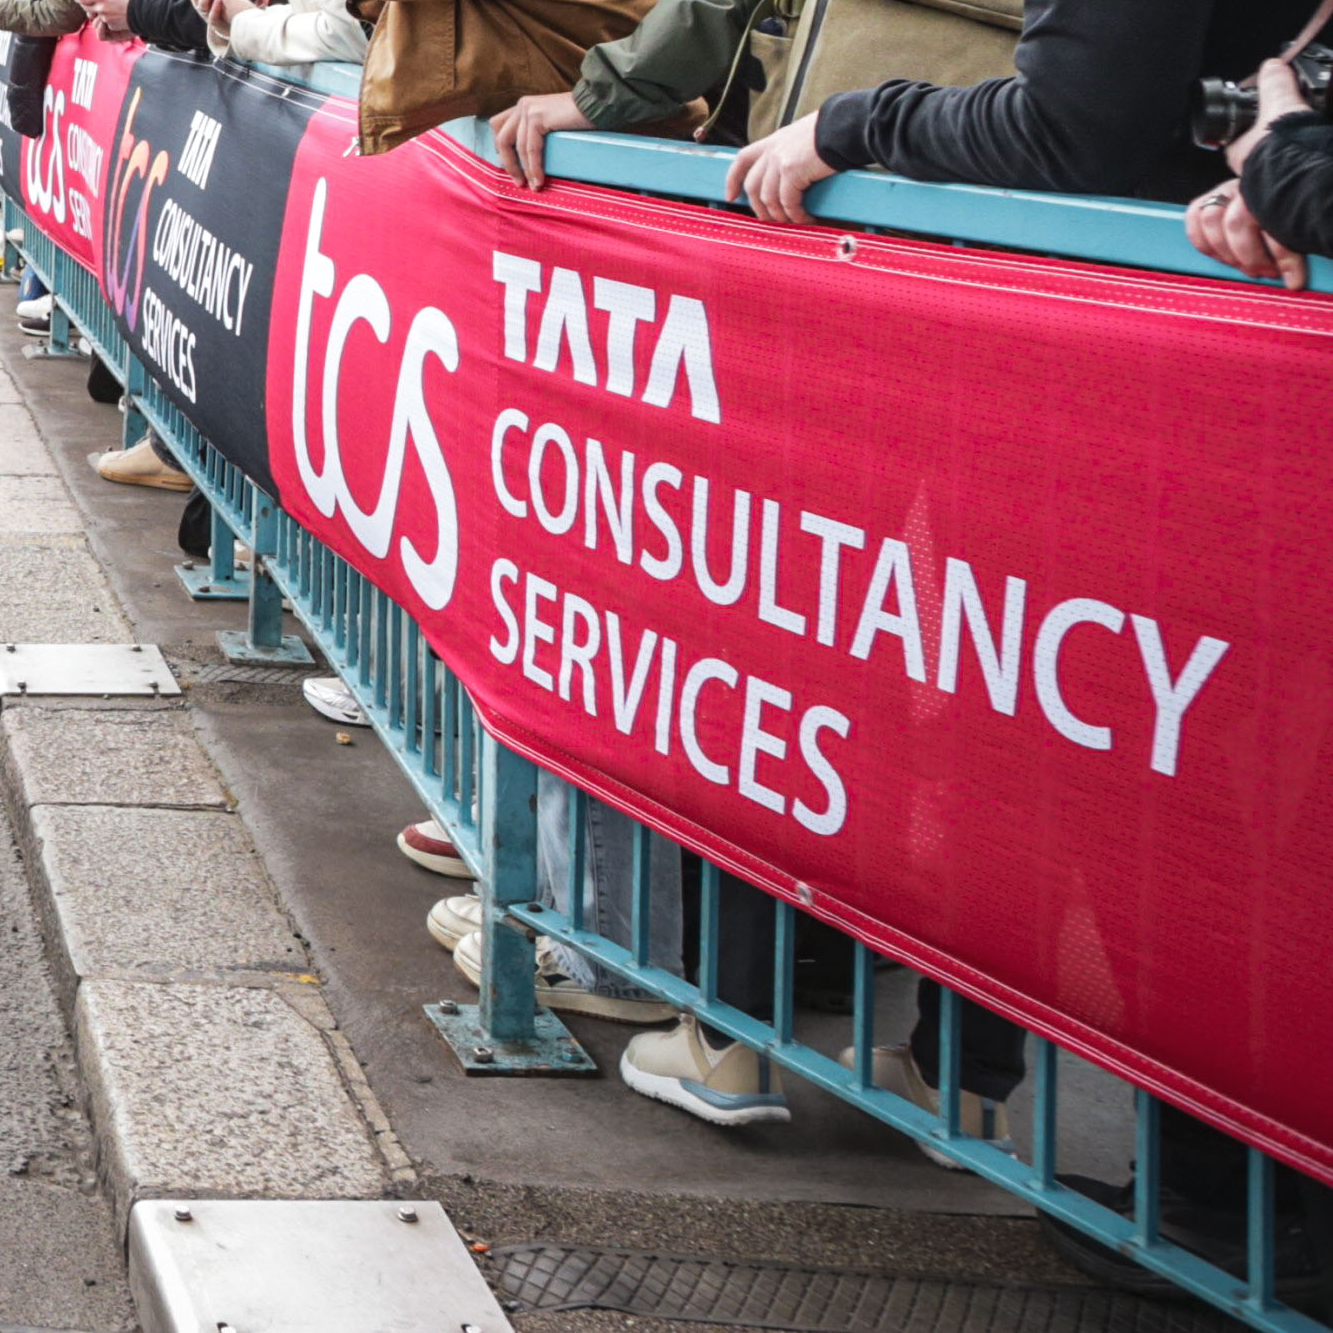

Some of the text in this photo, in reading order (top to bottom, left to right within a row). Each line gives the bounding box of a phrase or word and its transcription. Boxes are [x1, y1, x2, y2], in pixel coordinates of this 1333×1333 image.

[107, 87, 169, 332] tcs
[177, 111, 222, 190] TATA
[141, 287, 197, 404] SERVICES
[152, 198, 253, 336] CONSULTANCY
[492, 250, 721, 424] TATA
[292, 177, 459, 610] tcs
[490, 407, 1229, 777] CONSULTANCY
[489, 559, 852, 836] SERVICES
